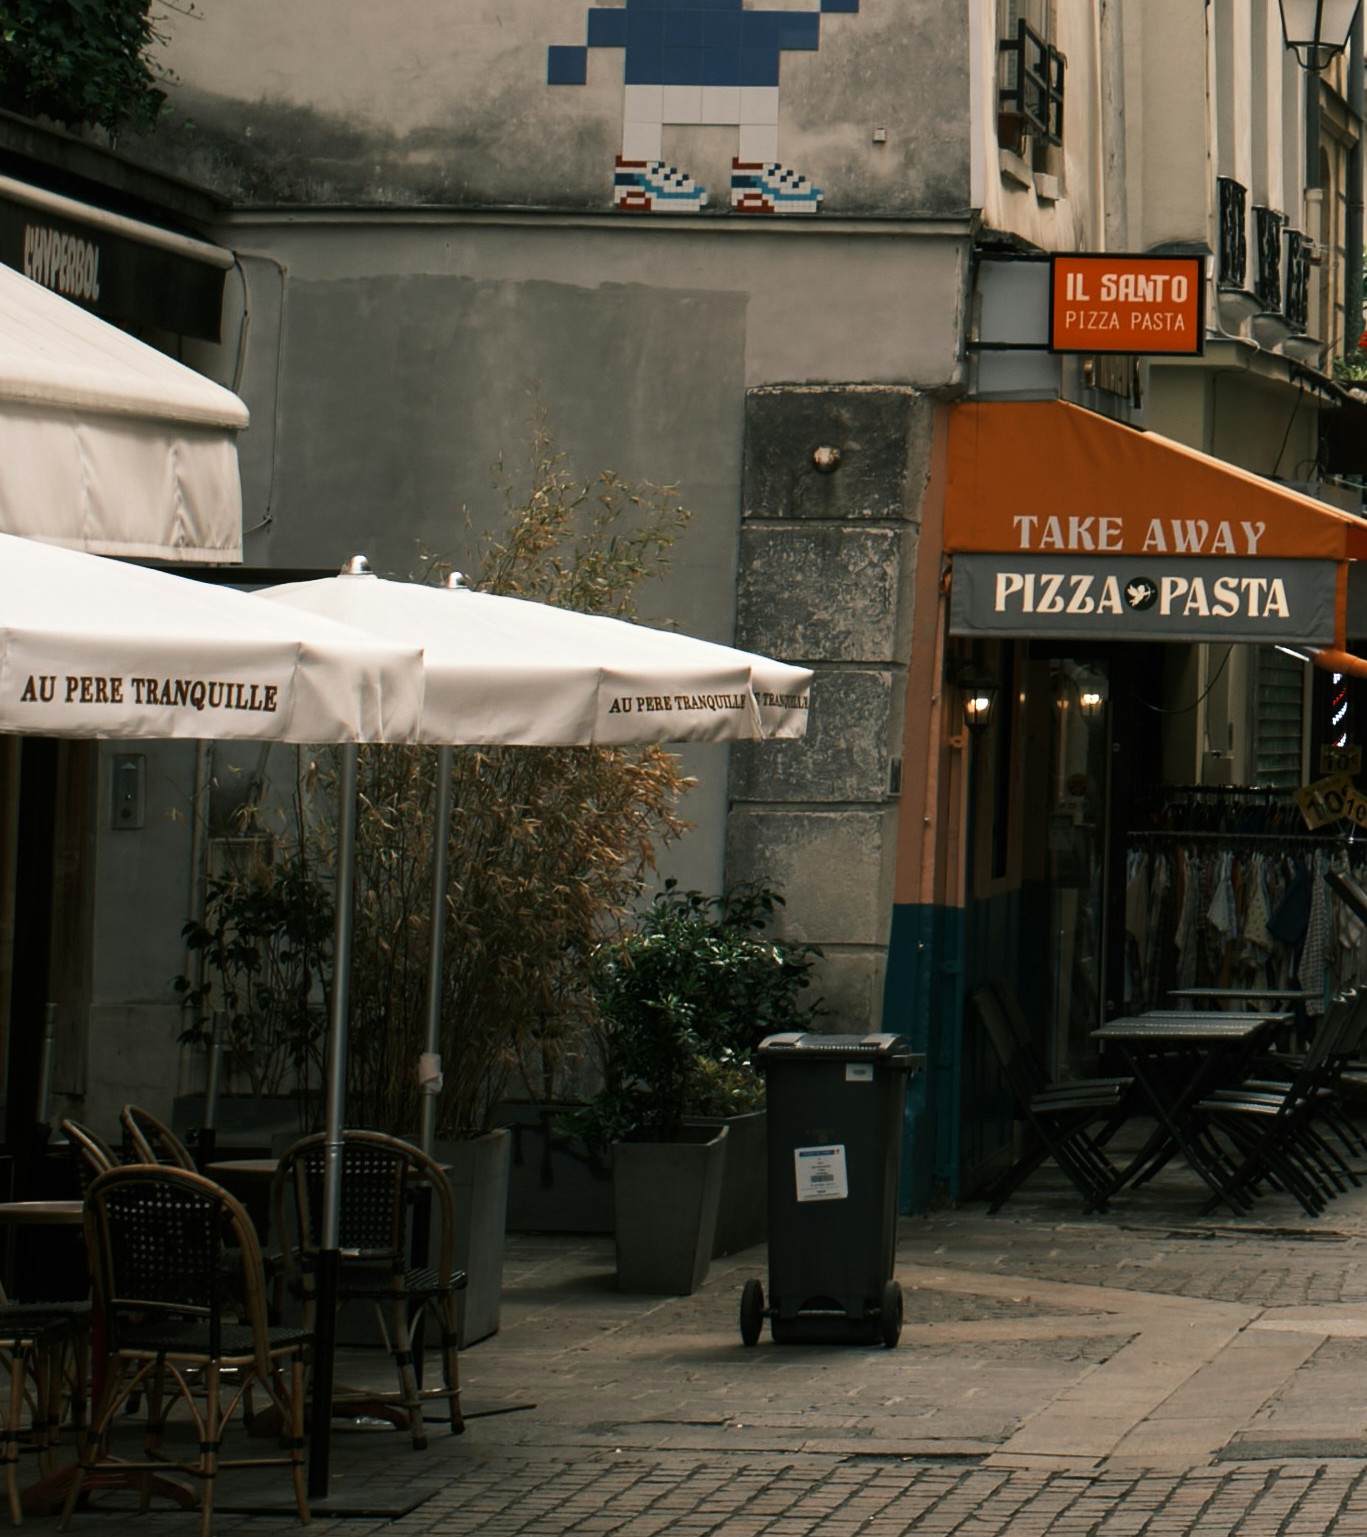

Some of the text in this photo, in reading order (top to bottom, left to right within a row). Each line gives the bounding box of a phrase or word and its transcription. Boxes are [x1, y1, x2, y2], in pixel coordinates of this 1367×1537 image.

[1066, 273, 1188, 304] IL SANTO
[1065, 310, 1185, 331] PIZZA PASTA
[1014, 515, 1267, 556] TAKE AWAY
[995, 572, 1290, 618] PIZZA PASTA
[20, 675, 278, 712] AU PERE TRANQUILLE
[609, 693, 747, 713] AU PERE TRANQUILLE
